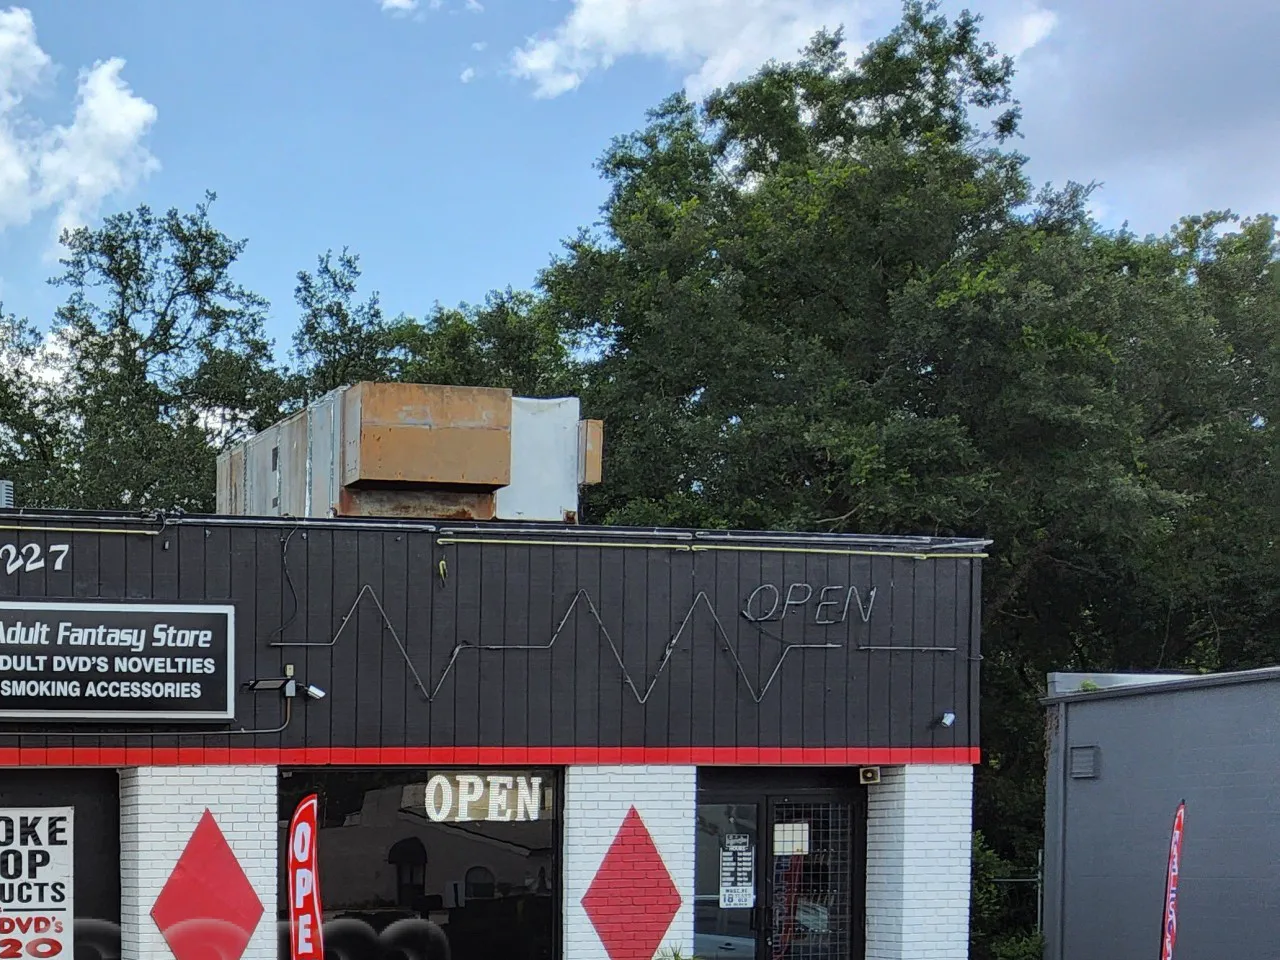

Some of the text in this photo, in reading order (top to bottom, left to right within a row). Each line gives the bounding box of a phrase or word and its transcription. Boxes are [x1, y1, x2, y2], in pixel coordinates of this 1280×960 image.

[742, 583, 877, 624] OPEN
[56, 622, 146, 652] Fantasy
[151, 624, 213, 648] Store
[52, 656, 109, 673] DVD'S
[114, 657, 216, 674] NOVELTIES
[0, 680, 202, 698] SMOKING ACCESSORIES
[424, 774, 542, 822] OPEN
[722, 893, 734, 903] 18
